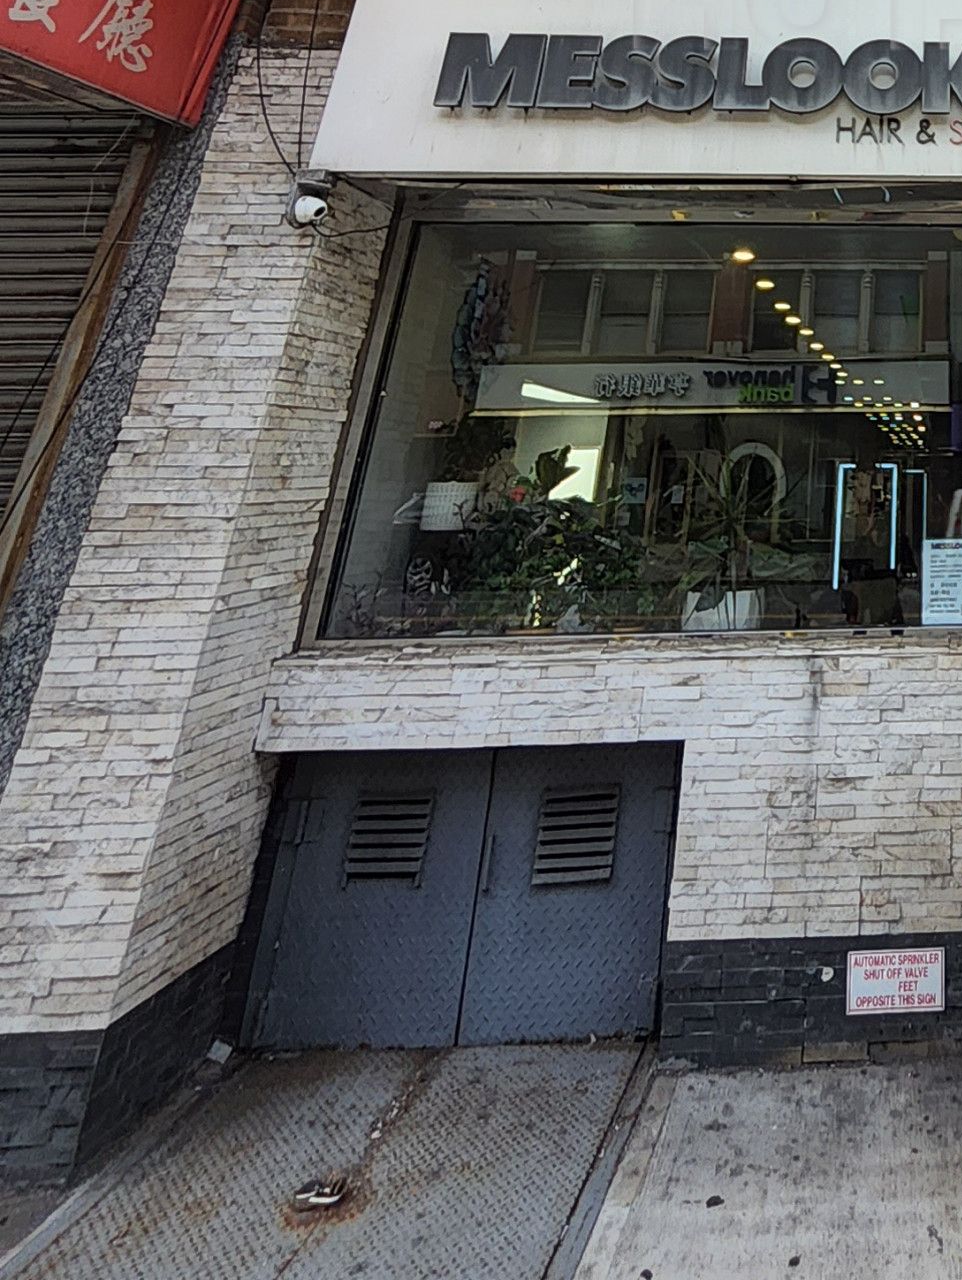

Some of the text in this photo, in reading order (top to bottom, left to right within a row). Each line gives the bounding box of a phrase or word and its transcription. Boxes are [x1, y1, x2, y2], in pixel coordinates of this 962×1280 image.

[836, 118, 902, 145] HAIR
[916, 119, 936, 145] &
[853, 953, 940, 967] AUTOMATIC SPRINKLER
[864, 967, 928, 980] SHUT OFF VALVE
[898, 981, 918, 992] FEET
[856, 993, 936, 1008] OPPOSITE THIS SIGN
